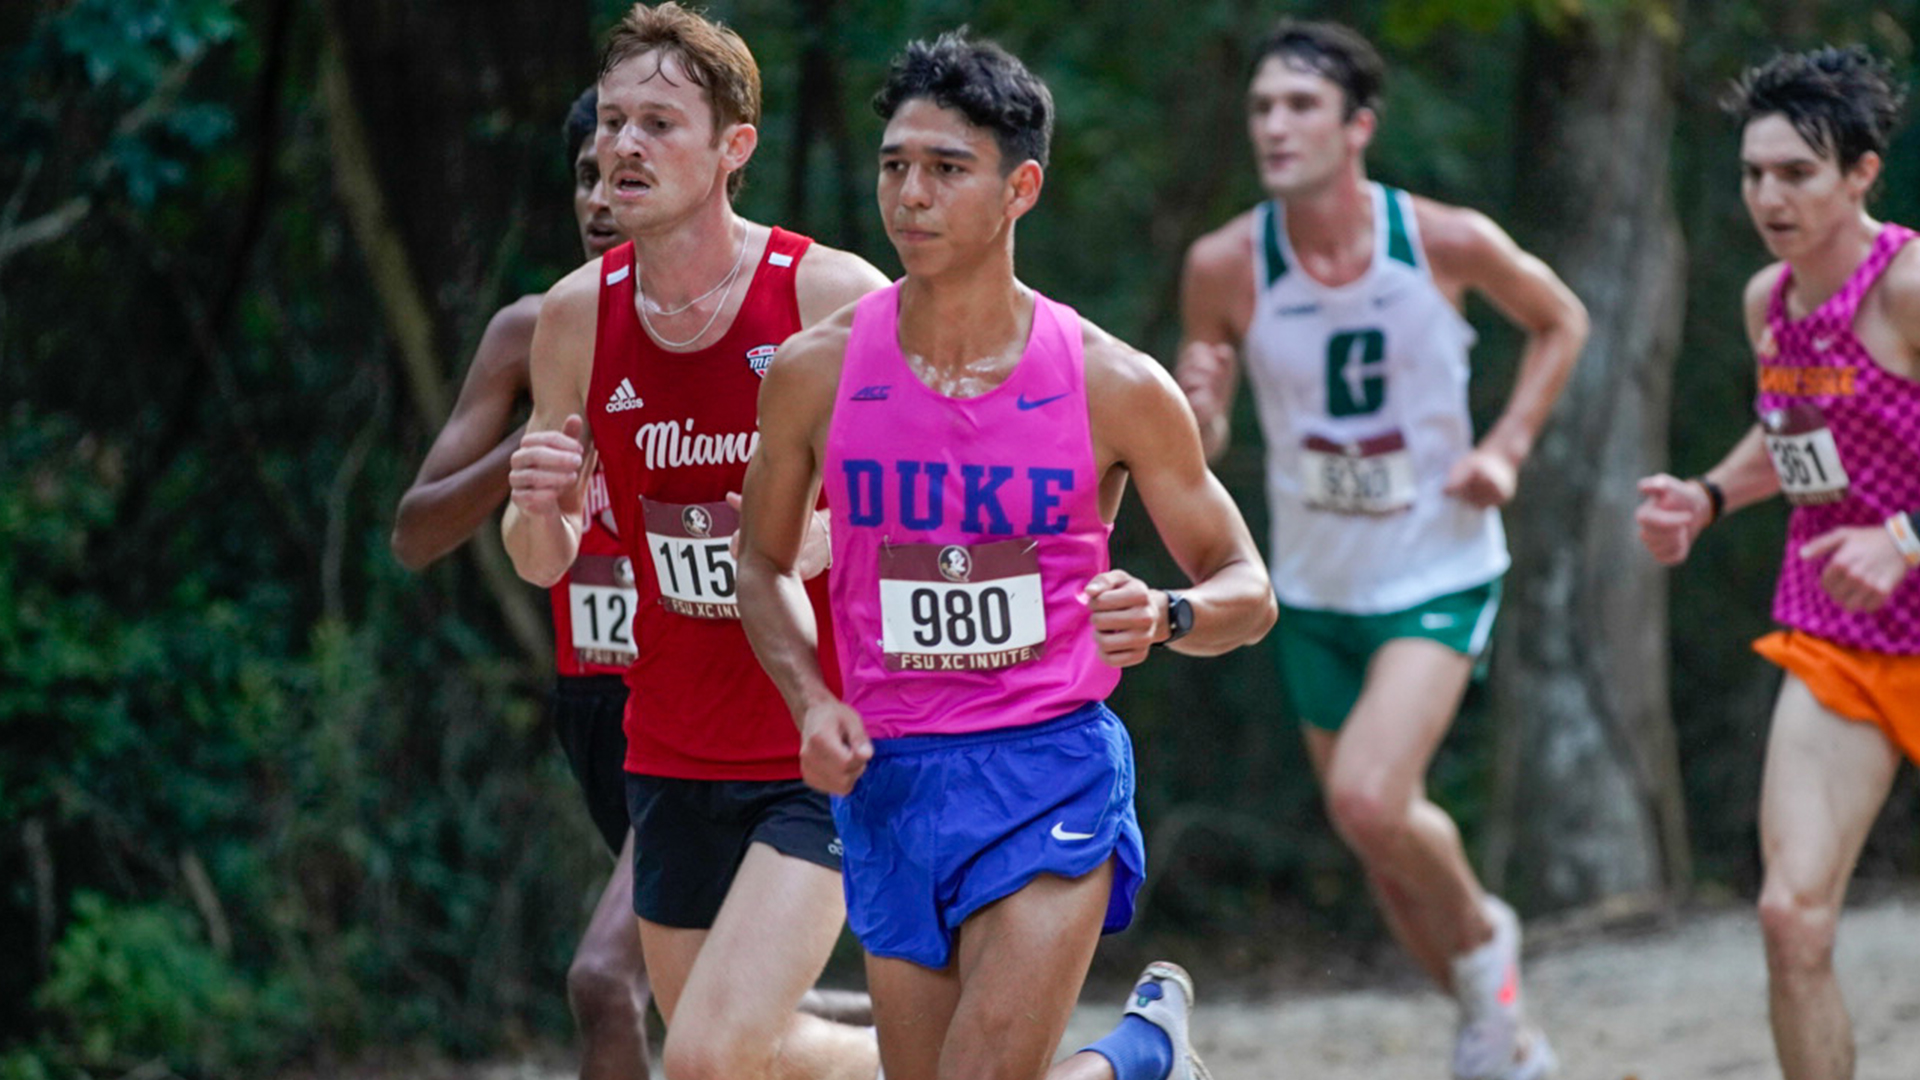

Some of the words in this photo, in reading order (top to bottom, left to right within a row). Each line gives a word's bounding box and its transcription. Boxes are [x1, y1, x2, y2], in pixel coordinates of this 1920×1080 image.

[605, 397, 644, 413] adidas
[851, 385, 892, 400] ACC
[1773, 442, 1828, 486] 361
[842, 459, 1074, 535] DUKE
[659, 541, 736, 598] 115
[583, 593, 629, 645] 12
[696, 603, 715, 618] XC
[911, 586, 1012, 647] 980
[901, 653, 935, 669] FSU
[941, 655, 965, 669] XC
[970, 647, 1030, 669] INVITE
